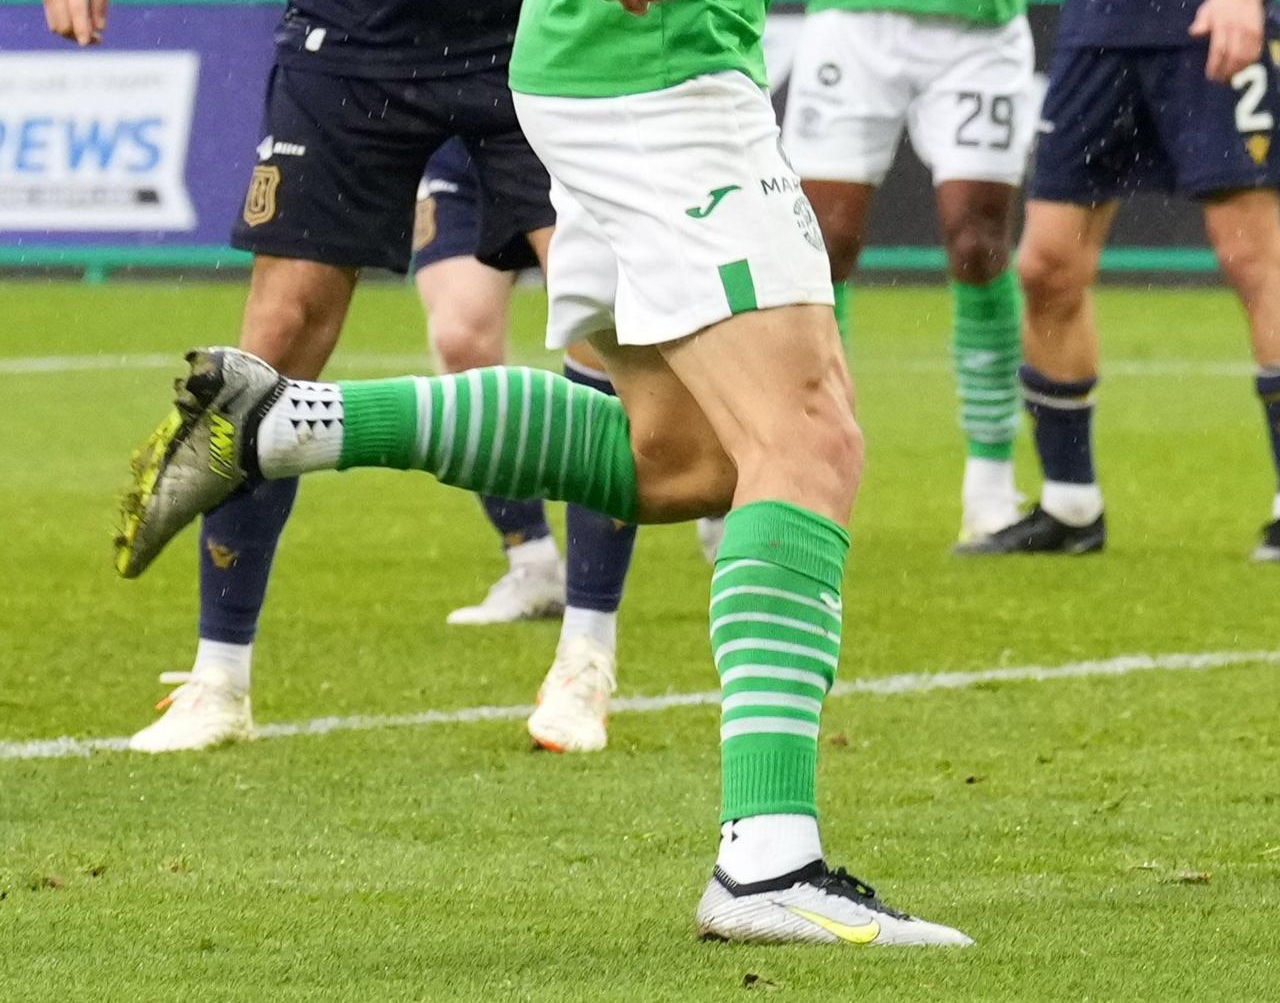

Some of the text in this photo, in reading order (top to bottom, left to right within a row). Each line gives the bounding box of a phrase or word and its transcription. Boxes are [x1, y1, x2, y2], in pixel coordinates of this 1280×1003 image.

[956, 92, 1013, 150] 29
[1231, 63, 1273, 132] 2
[0, 117, 161, 173] EWS
